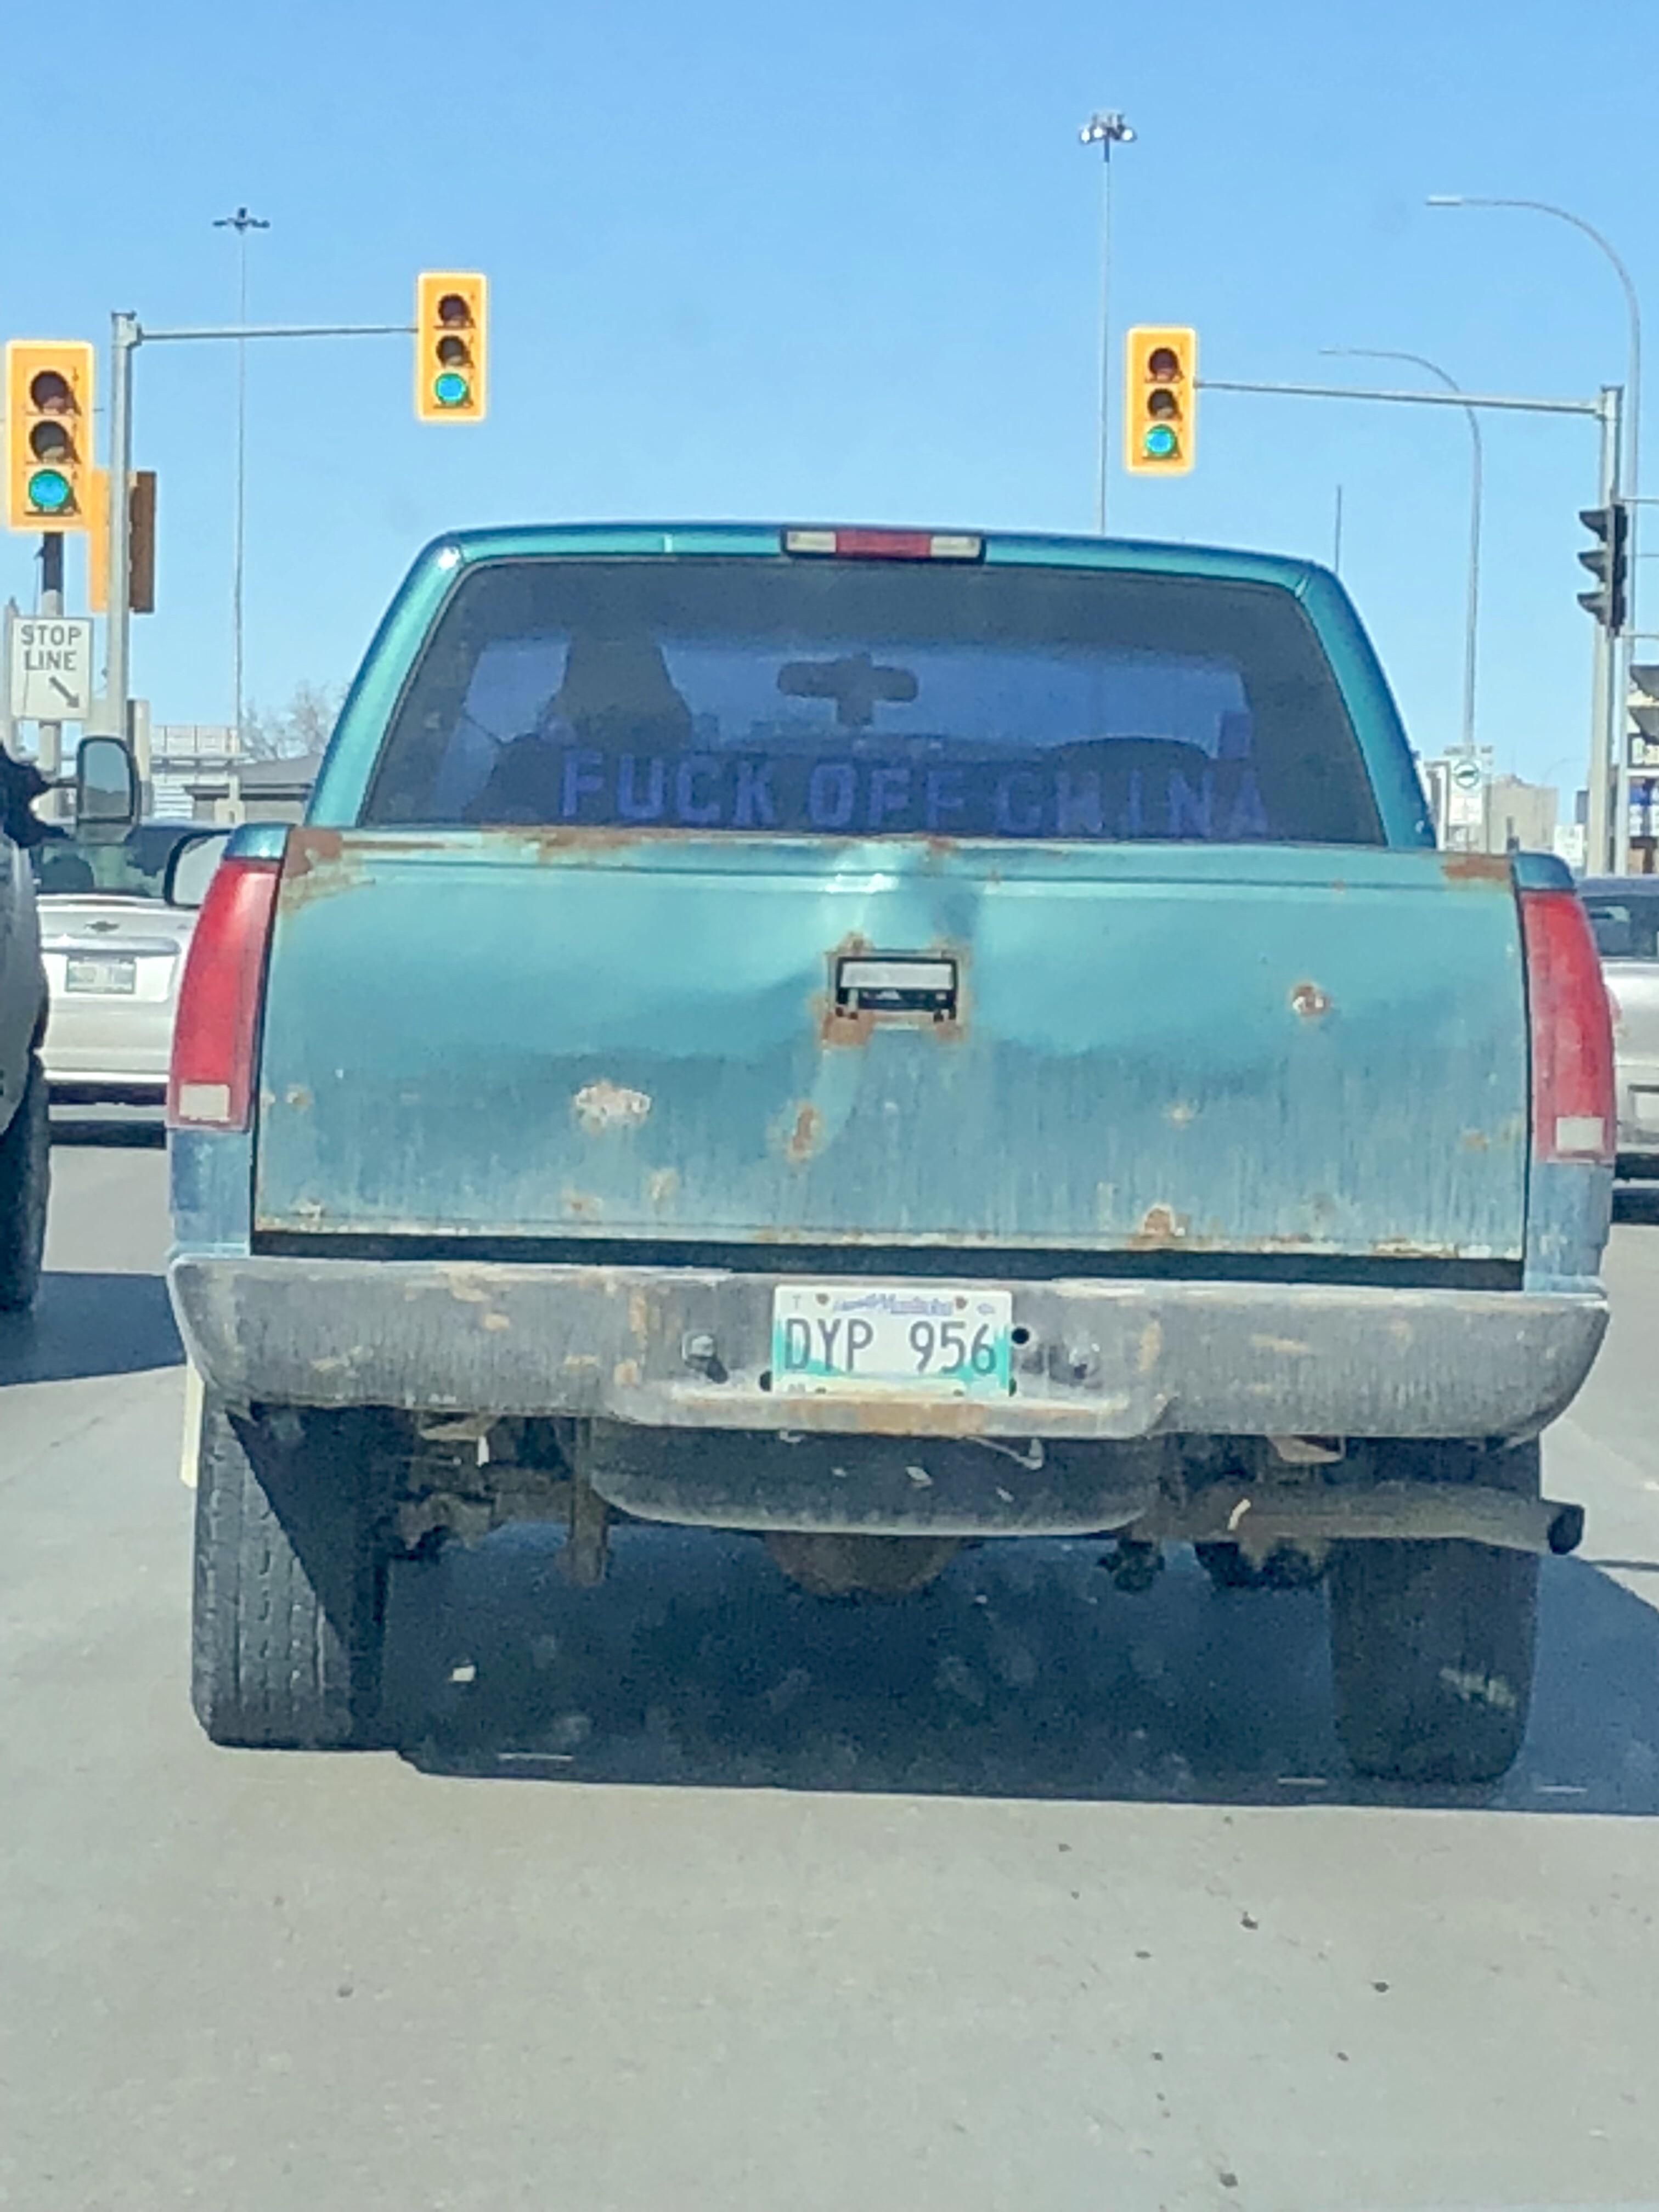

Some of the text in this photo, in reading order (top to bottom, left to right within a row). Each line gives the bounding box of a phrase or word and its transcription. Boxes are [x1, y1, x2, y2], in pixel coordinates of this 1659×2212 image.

[21, 624, 82, 646] STOP
[24, 650, 77, 671] LINE
[561, 749, 1268, 837] FUCK OFF CHINA
[785, 1317, 998, 1375] DYP 956
